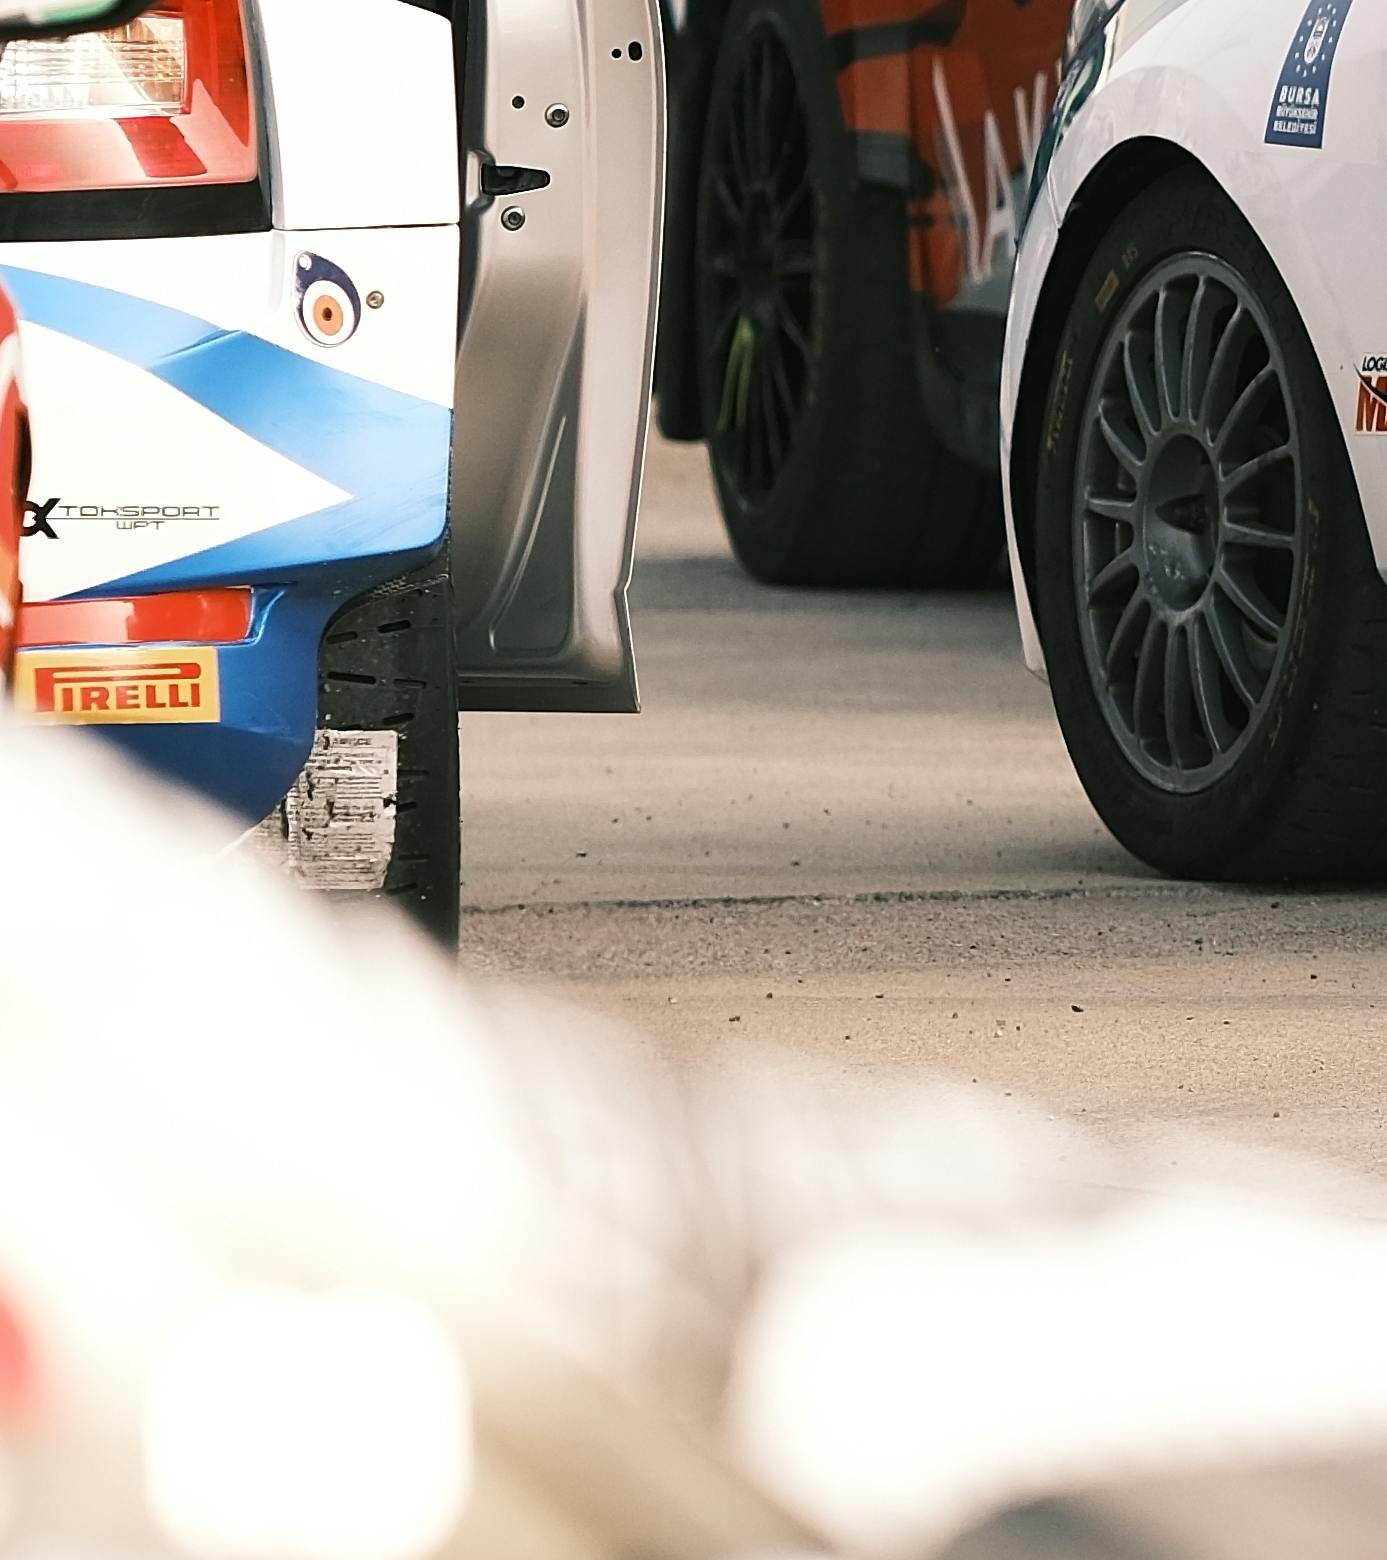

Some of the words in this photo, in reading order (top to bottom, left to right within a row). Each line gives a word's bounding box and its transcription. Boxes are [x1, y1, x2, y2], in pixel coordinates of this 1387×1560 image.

[1279, 85, 1320, 106] BURSA
[58, 505, 220, 518] TOKSPORT
[34, 662, 202, 713] PIRELLI
